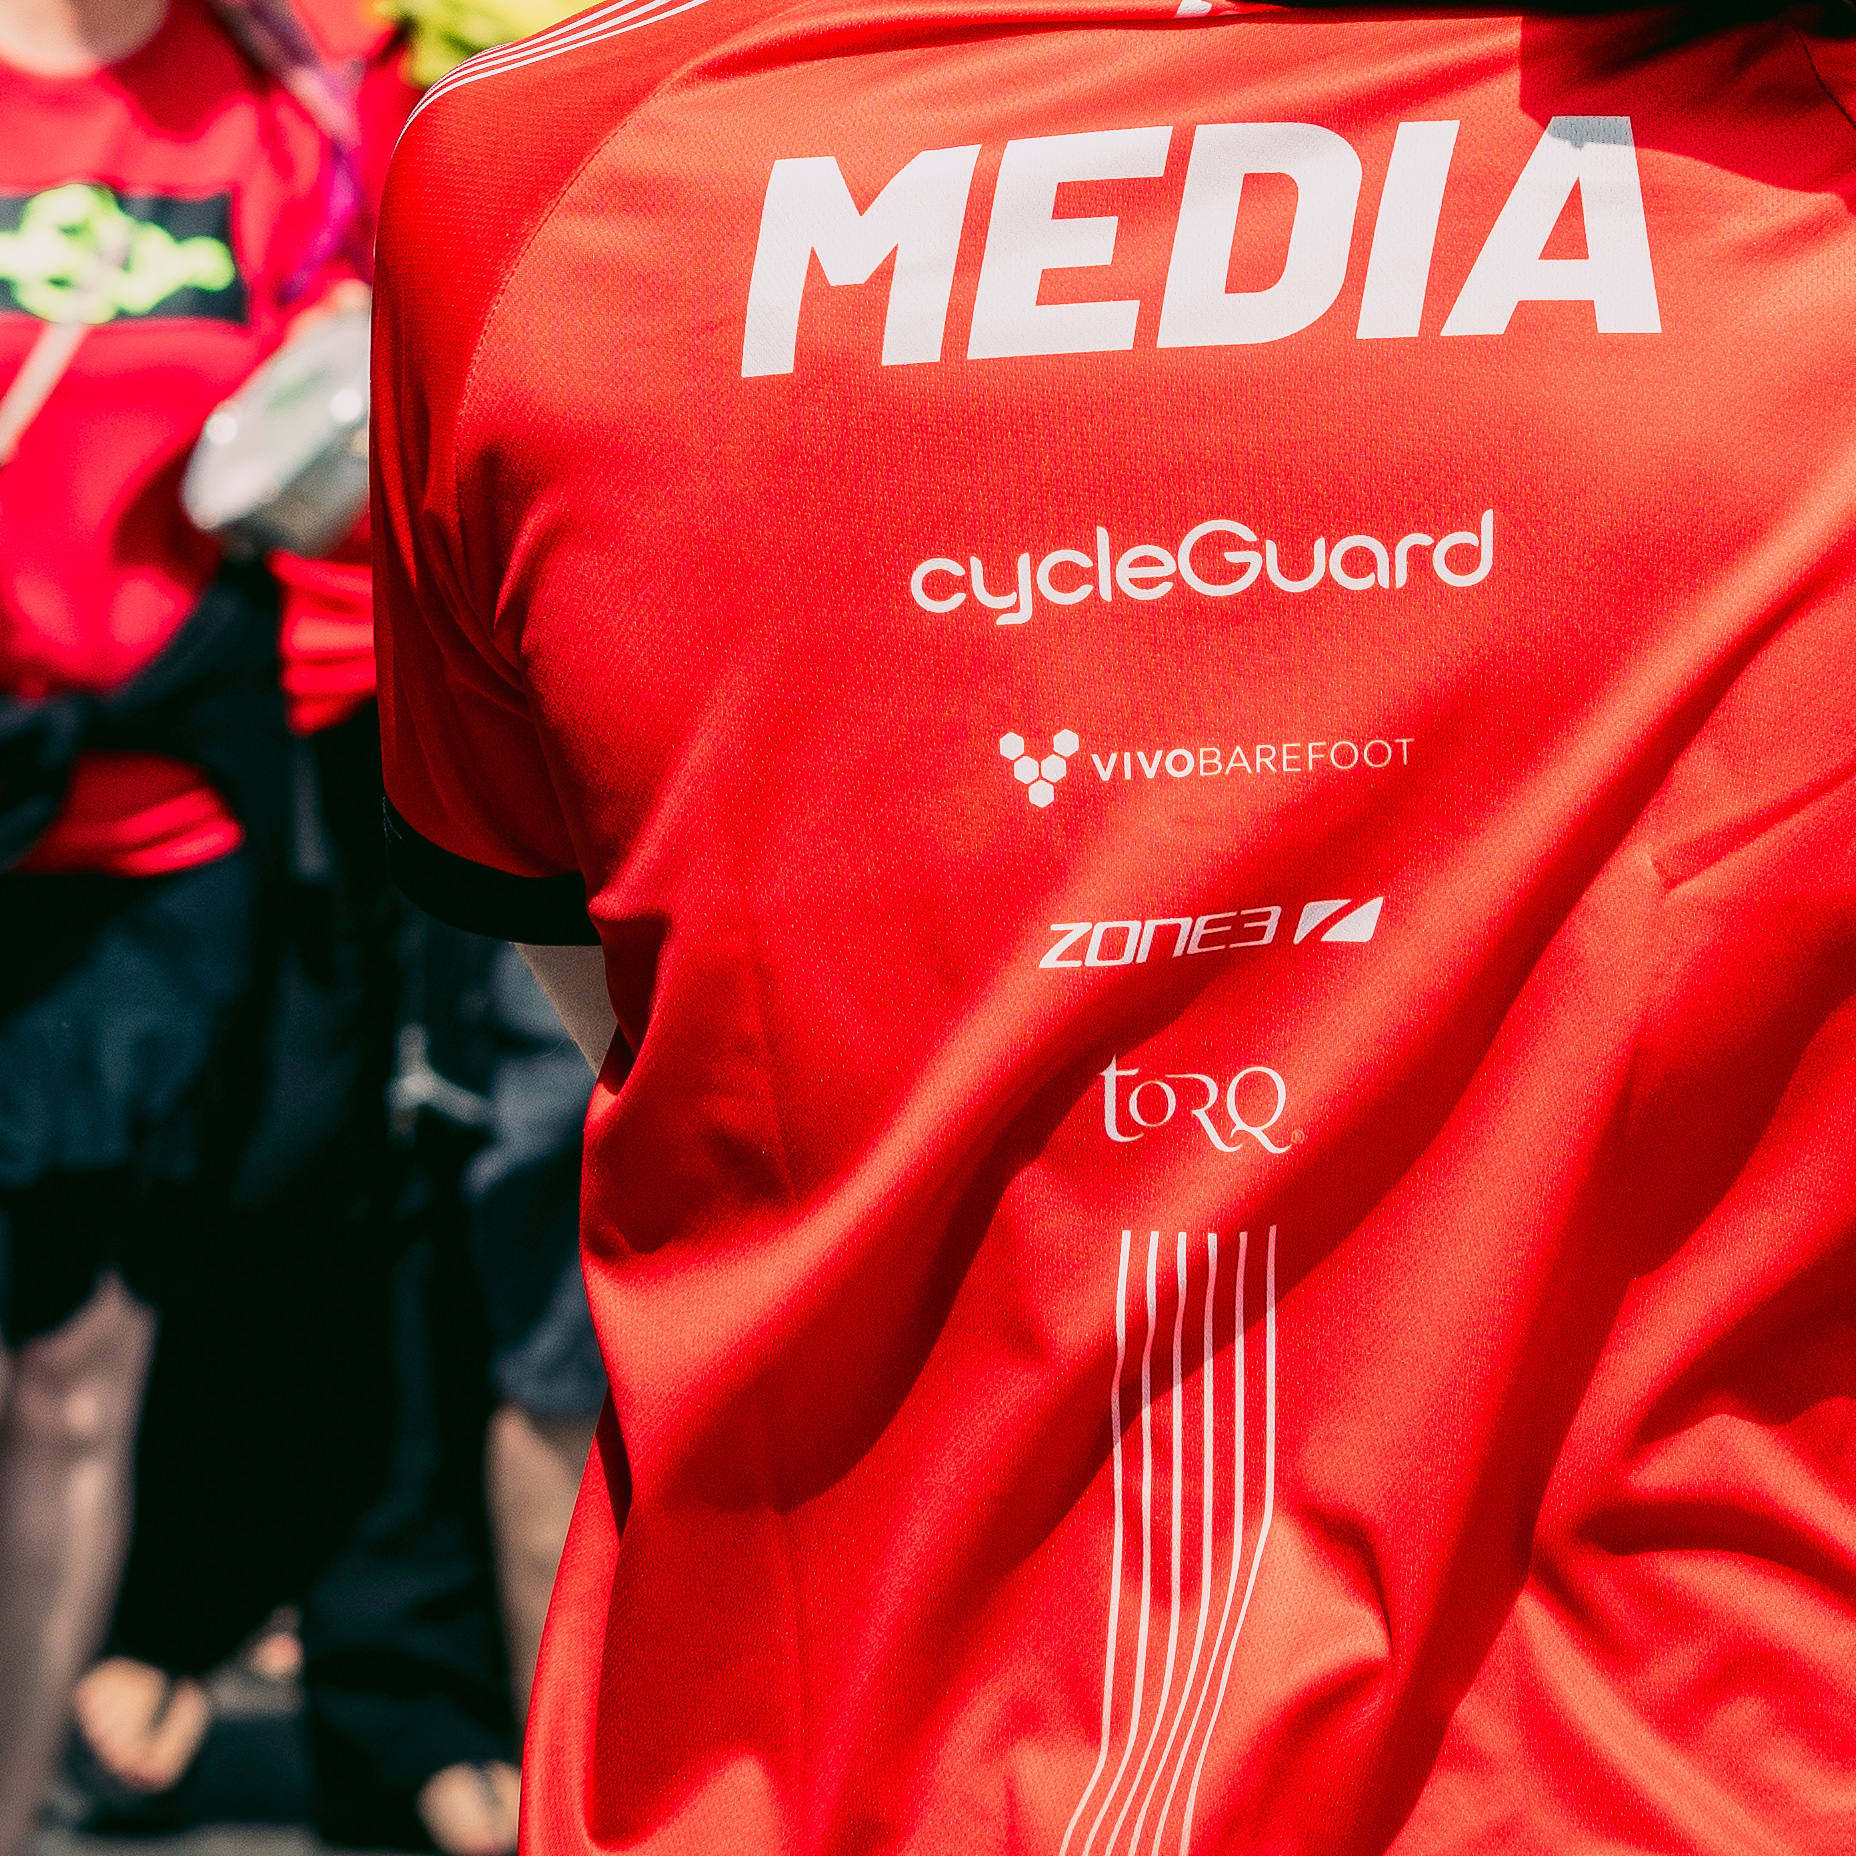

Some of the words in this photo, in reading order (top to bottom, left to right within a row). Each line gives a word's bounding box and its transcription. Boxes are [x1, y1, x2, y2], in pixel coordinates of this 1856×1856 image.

[740, 114, 1662, 378] MEDIA
[910, 508, 1494, 626] cycleGuard
[1091, 737, 1415, 781] VIVOBAREFOOT
[1038, 905, 1282, 969] ZONE3
